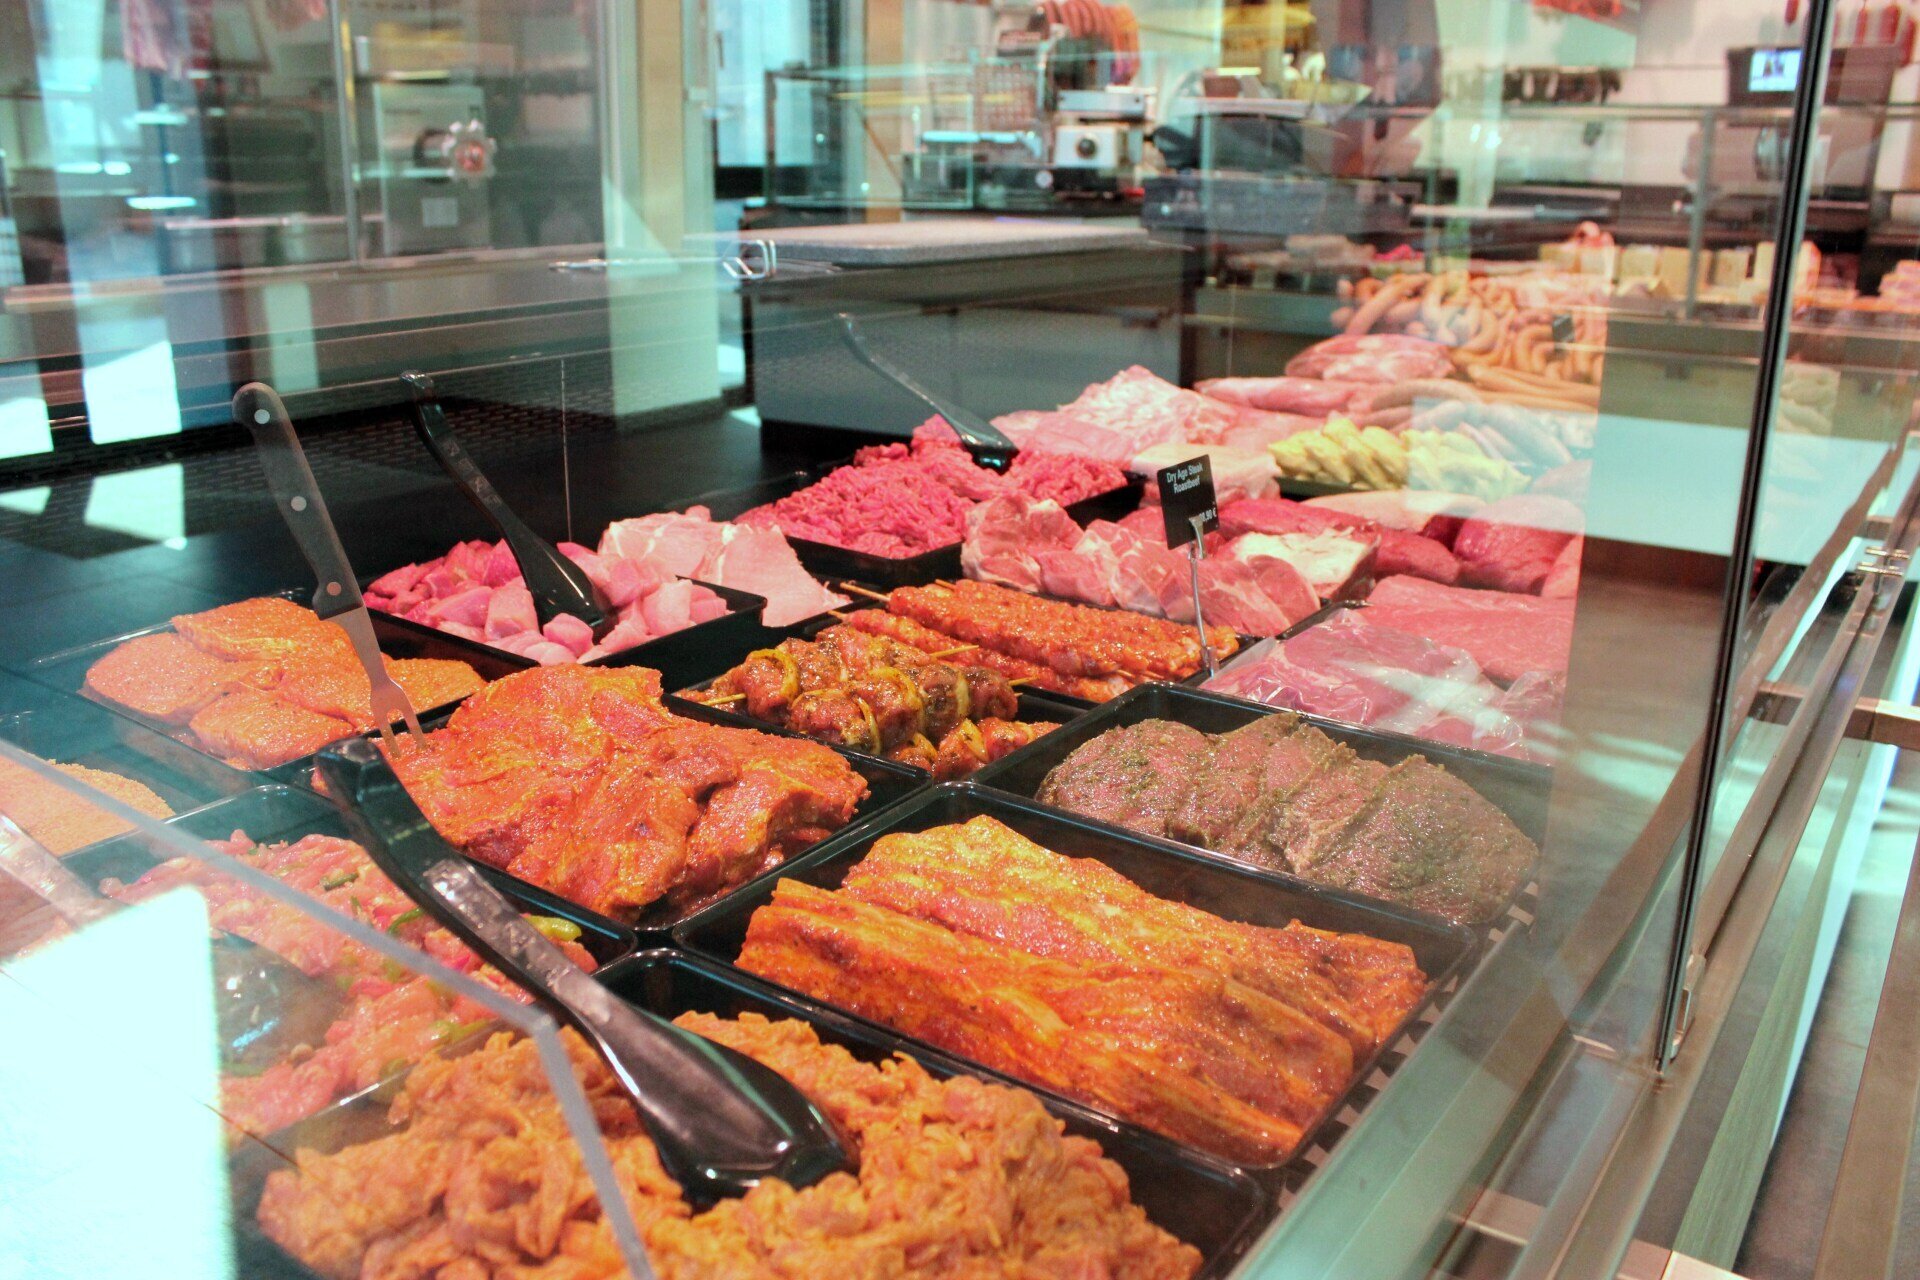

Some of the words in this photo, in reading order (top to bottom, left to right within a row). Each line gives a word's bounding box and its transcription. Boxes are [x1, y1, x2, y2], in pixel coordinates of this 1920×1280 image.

[1166, 472, 1177, 484] Dry
[1177, 469, 1188, 481] Age
[1188, 463, 1203, 475] Steak
[1174, 476, 1200, 494] Roastbeef
